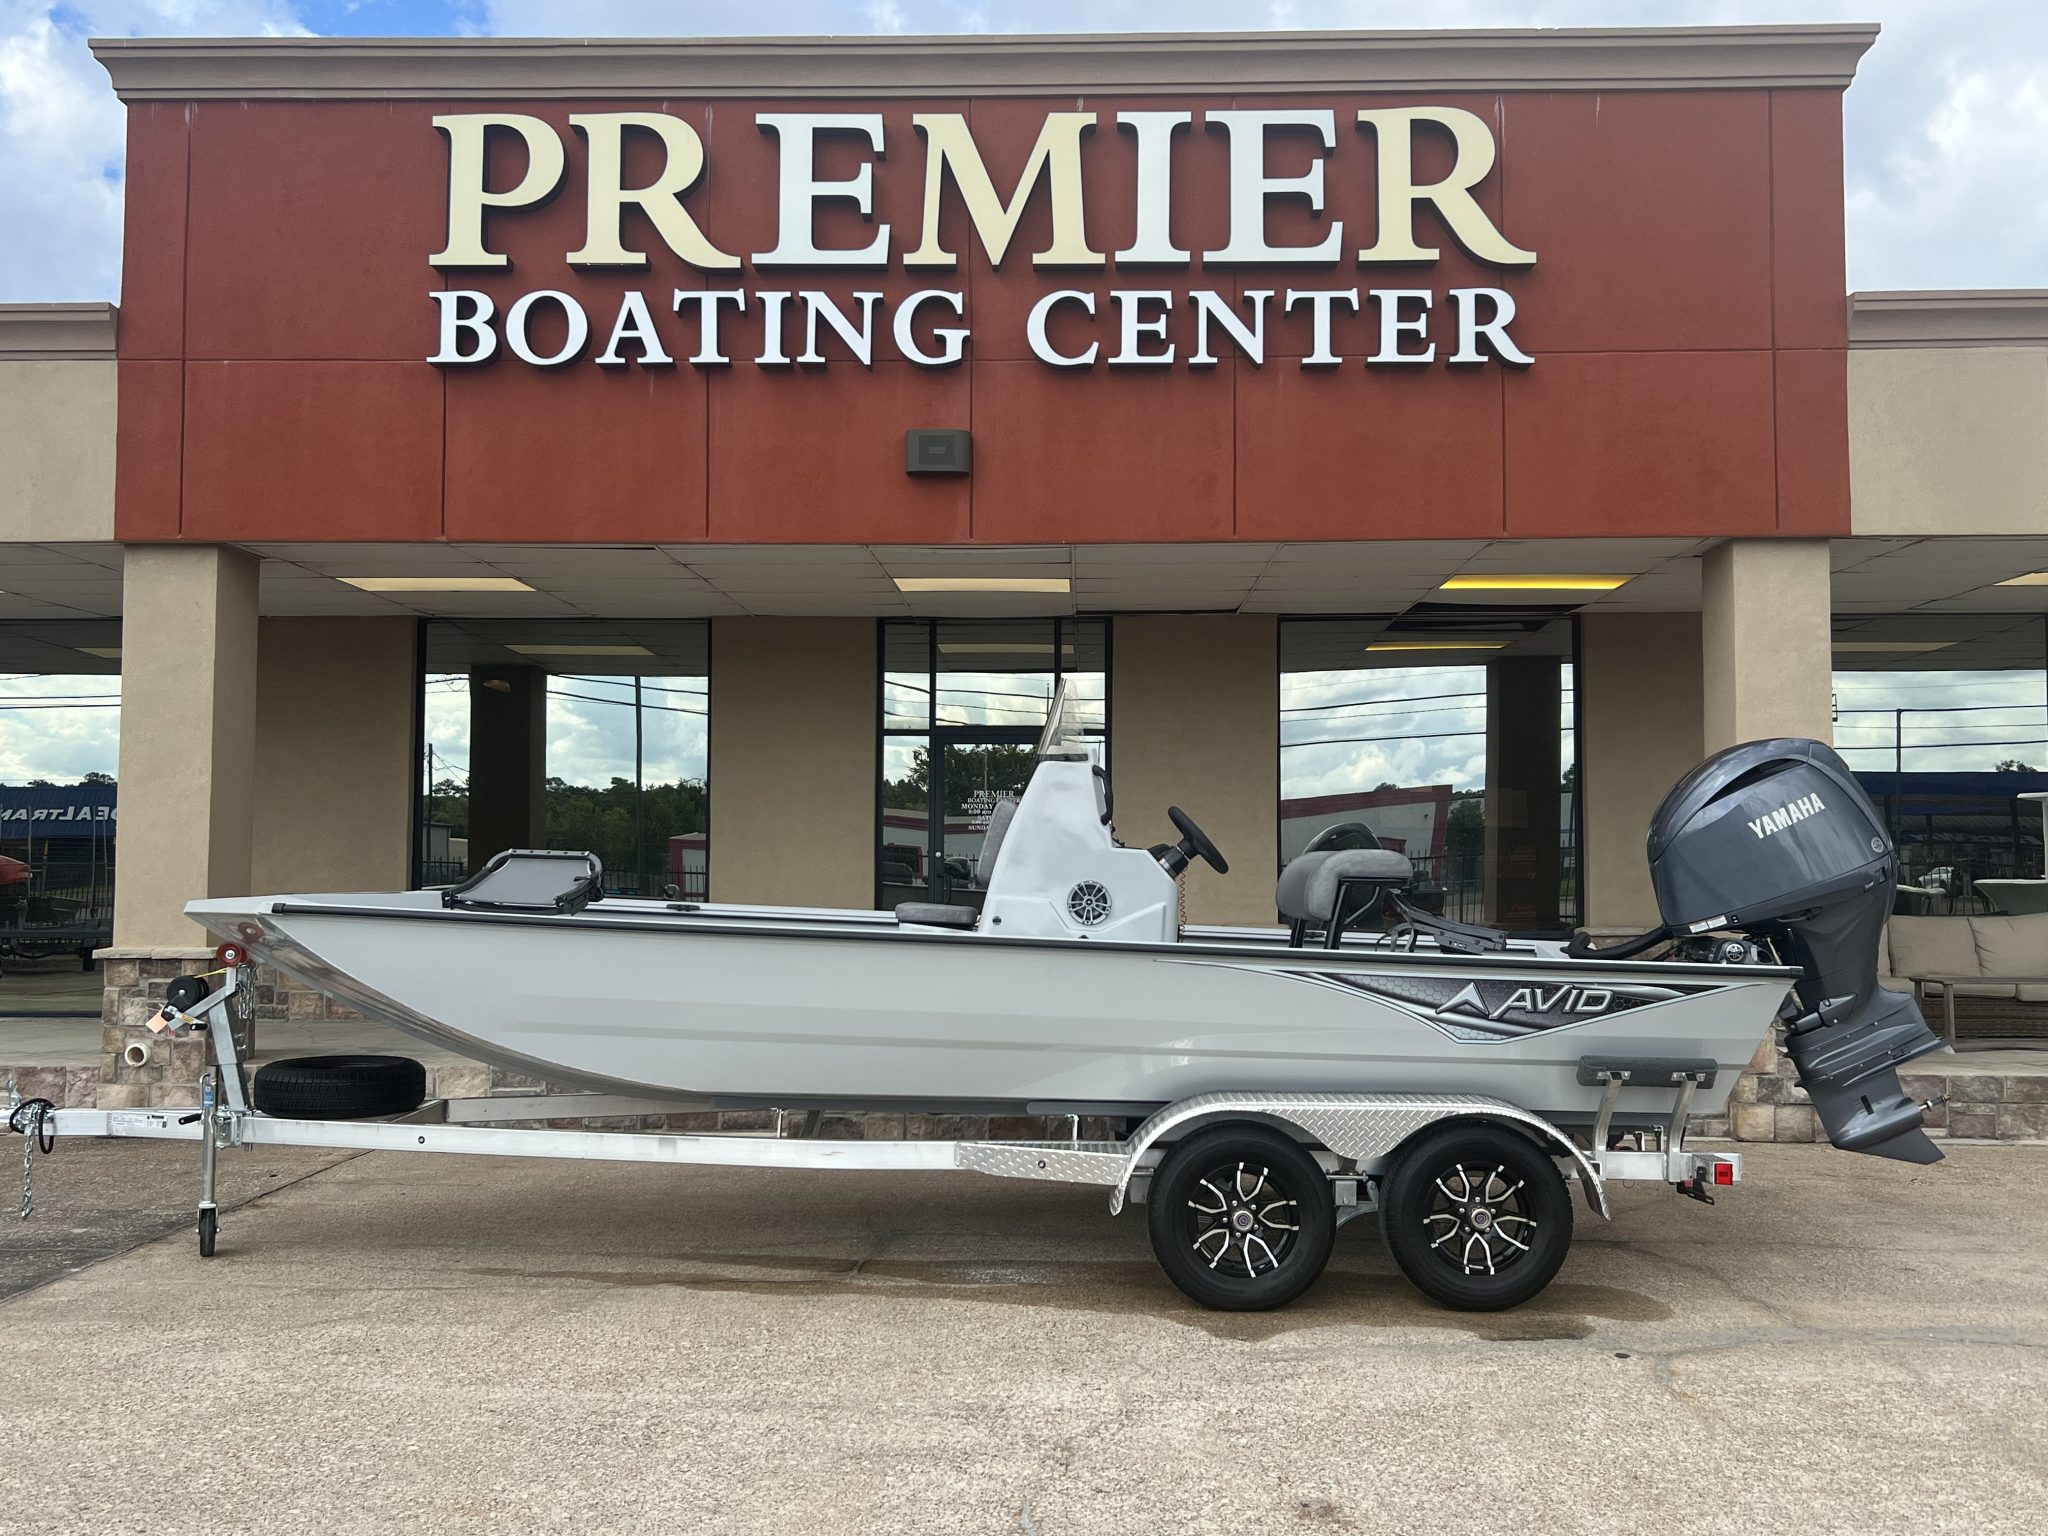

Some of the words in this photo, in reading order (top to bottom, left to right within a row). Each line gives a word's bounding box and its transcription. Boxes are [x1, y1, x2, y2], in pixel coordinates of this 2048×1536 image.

[428, 105, 1538, 270] PREMIER
[426, 287, 972, 367] BOATING
[1026, 286, 1536, 367] CENTER
[1747, 792, 1826, 839] YAMAHA
[1488, 984, 1614, 1020] AVID
